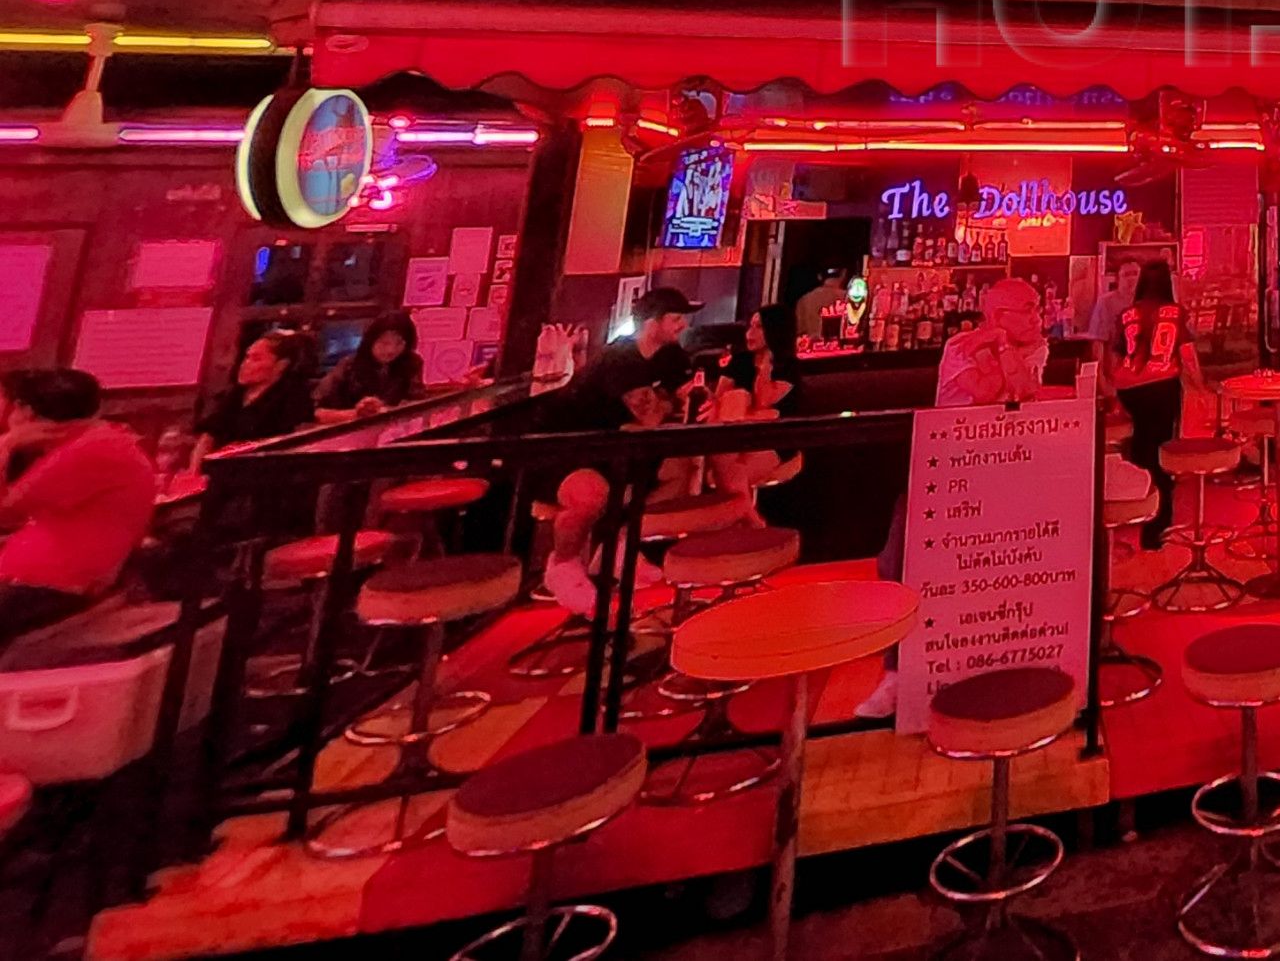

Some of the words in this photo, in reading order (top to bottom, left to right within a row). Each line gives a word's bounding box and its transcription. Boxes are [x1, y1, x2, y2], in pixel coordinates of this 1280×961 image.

[881, 179, 950, 220] The
[972, 179, 1128, 219] Dollhouse
[952, 415, 1060, 442] รับสมัครงาน
[950, 444, 1033, 468] พนักงานเต้น
[948, 479, 968, 494] PR
[966, 644, 1064, 669] 086-6775027
